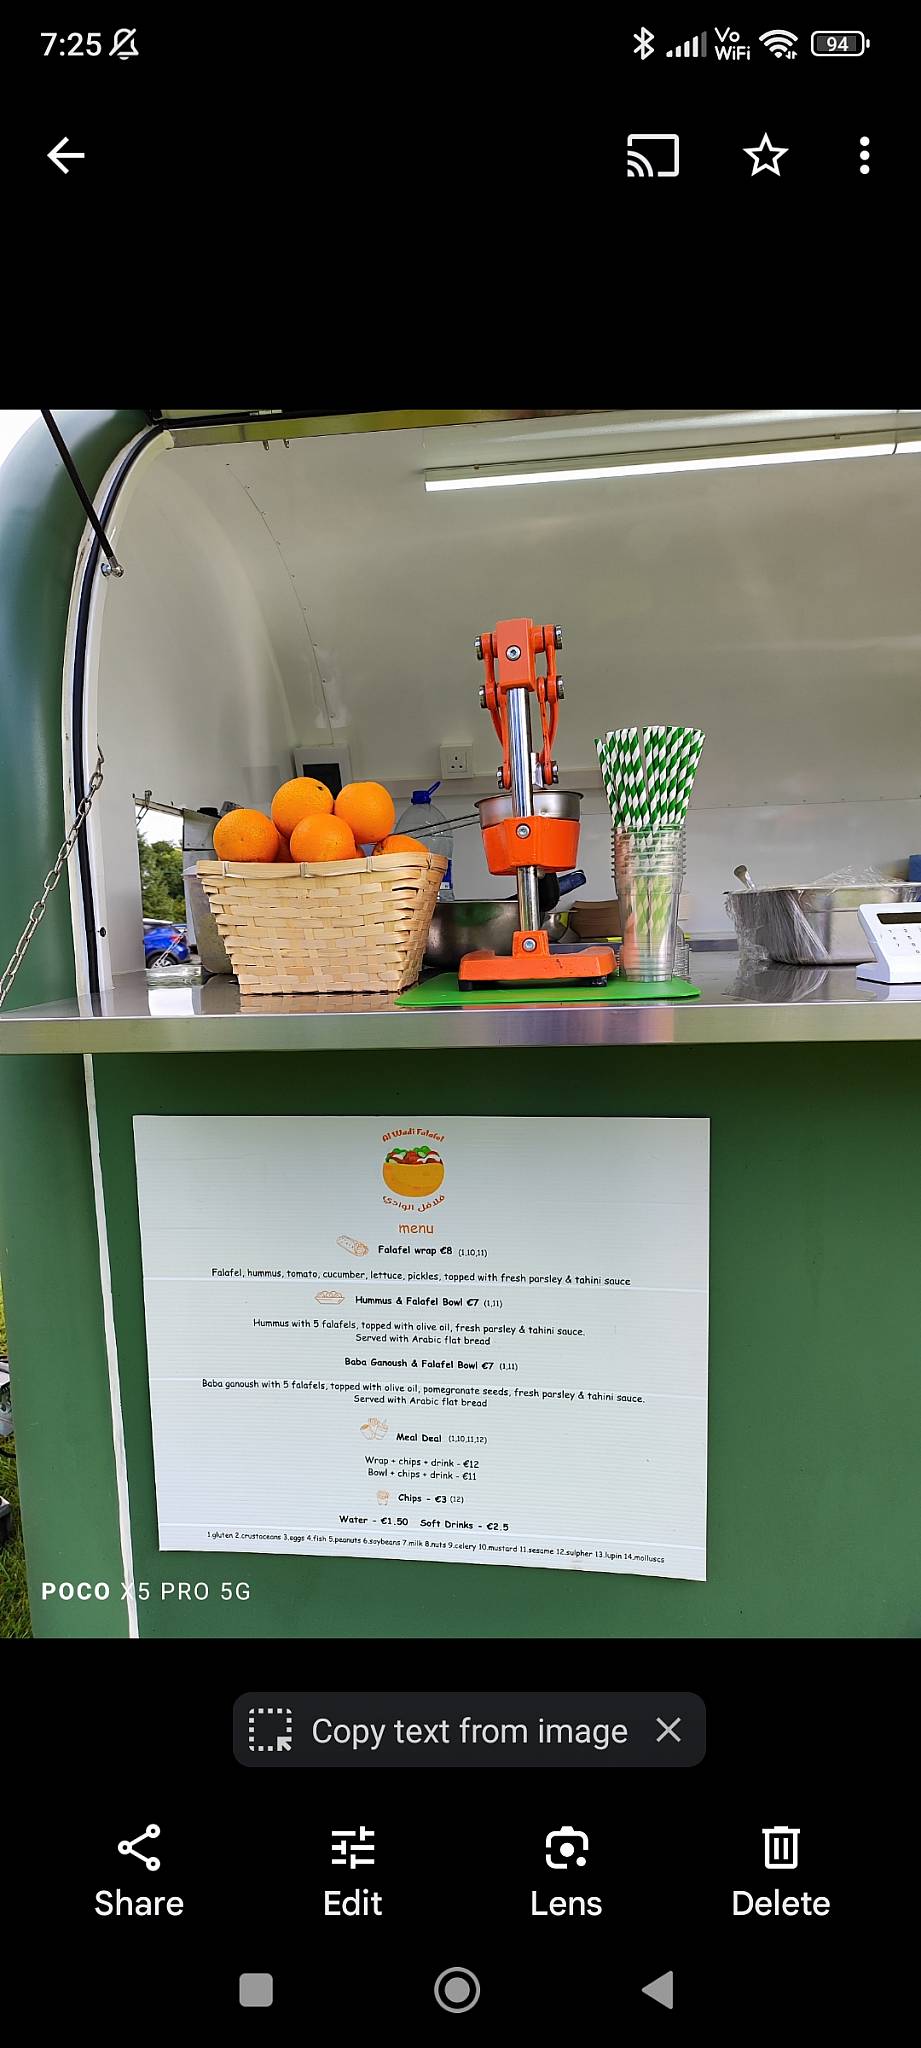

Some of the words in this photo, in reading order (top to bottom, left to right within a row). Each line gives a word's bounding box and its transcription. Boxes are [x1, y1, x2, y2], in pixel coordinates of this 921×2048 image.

[715, 27, 740, 42] Vo
[41, 33, 101, 56] 7:25
[827, 36, 849, 51] 94
[715, 46, 750, 60] WiFi
[393, 1128, 415, 1138] Wadi
[416, 1128, 445, 1142] Falafel
[399, 1222, 433, 1234] menu
[378, 1244, 410, 1254] Falafel
[414, 1247, 436, 1256] wrap
[440, 1245, 452, 1254] €8
[212, 1267, 244, 1278] Falafel,
[247, 1268, 284, 1278] hummus,
[286, 1269, 320, 1279] tomato,
[323, 1269, 368, 1280] cucumber,
[371, 1269, 405, 1280] lettuce,
[408, 1271, 441, 1281] pickles,
[444, 1272, 475, 1282] topped
[478, 1272, 497, 1281] with
[501, 1272, 526, 1282] fresh
[529, 1274, 562, 1285] parsley
[565, 1274, 572, 1283] &
[575, 1274, 601, 1284] tahini
[604, 1277, 630, 1285] sauce
[356, 1295, 392, 1304] Hummus
[396, 1296, 402, 1305] &
[406, 1296, 438, 1306] Falafel
[443, 1297, 462, 1306] Bowl
[467, 1298, 479, 1306] €7
[254, 1317, 289, 1327] Hummus
[292, 1319, 311, 1327] with
[314, 1319, 319, 1328] 5
[322, 1319, 358, 1330] falafels,
[361, 1320, 391, 1331] topped
[394, 1321, 413, 1330] with
[416, 1321, 437, 1331] olive
[438, 1322, 452, 1332] oil,
[455, 1322, 480, 1332] fresh
[483, 1323, 516, 1335] parsley
[519, 1324, 525, 1333] &
[528, 1325, 554, 1334] tahini
[557, 1328, 585, 1336] sauce.
[356, 1333, 387, 1342] Served
[389, 1333, 409, 1342] with
[412, 1334, 441, 1343] Arabic
[445, 1335, 461, 1344] flat
[464, 1335, 490, 1345] bread
[345, 1356, 367, 1366] Baba
[371, 1357, 407, 1367] Ganoush
[411, 1358, 418, 1367] &
[422, 1359, 453, 1368] Falafel
[458, 1360, 477, 1369] Bowl
[481, 1361, 494, 1370] €7
[203, 1378, 223, 1387] Baba
[225, 1379, 259, 1390] ganoush
[262, 1380, 280, 1388] with
[284, 1380, 288, 1388] 5
[292, 1379, 328, 1391] falafels,
[330, 1382, 360, 1392] topped
[363, 1381, 381, 1391] with
[385, 1383, 405, 1392] olive
[407, 1383, 420, 1394] oil,
[423, 1386, 480, 1396] pomegranate
[483, 1386, 511, 1397] seeds,
[514, 1387, 539, 1399] fresh
[542, 1389, 575, 1401] parsley
[578, 1390, 584, 1399] &
[587, 1391, 613, 1400] tahini
[617, 1394, 645, 1403] sauce.
[354, 1394, 385, 1403] Served
[388, 1395, 406, 1404] with
[410, 1396, 439, 1405] Arabic
[442, 1396, 458, 1406] flat
[461, 1397, 487, 1407] bread
[396, 1432, 417, 1441] Meal
[422, 1433, 441, 1442] Deal
[365, 1455, 388, 1466] Wrap
[398, 1456, 421, 1467] chips
[431, 1457, 454, 1467] drink
[463, 1459, 479, 1468] €12
[368, 1467, 387, 1476] Bowl
[398, 1468, 420, 1479] chips
[430, 1469, 453, 1479] drink
[462, 1471, 476, 1480] €11
[398, 1493, 422, 1504] Chips
[435, 1495, 447, 1503] €3
[339, 1514, 368, 1523] Water
[380, 1516, 408, 1526] €1.50
[420, 1518, 440, 1528] Soft
[445, 1519, 473, 1529] Drinks
[486, 1522, 509, 1531] €2.5
[313, 1719, 385, 1750] Copy
[394, 1720, 449, 1743] text
[460, 1717, 527, 1743] from
[540, 1719, 627, 1750] image
[95, 1889, 183, 1916] Share
[325, 1889, 382, 1916] Edit
[532, 1891, 602, 1916] Lens
[733, 1889, 830, 1916] Delete
